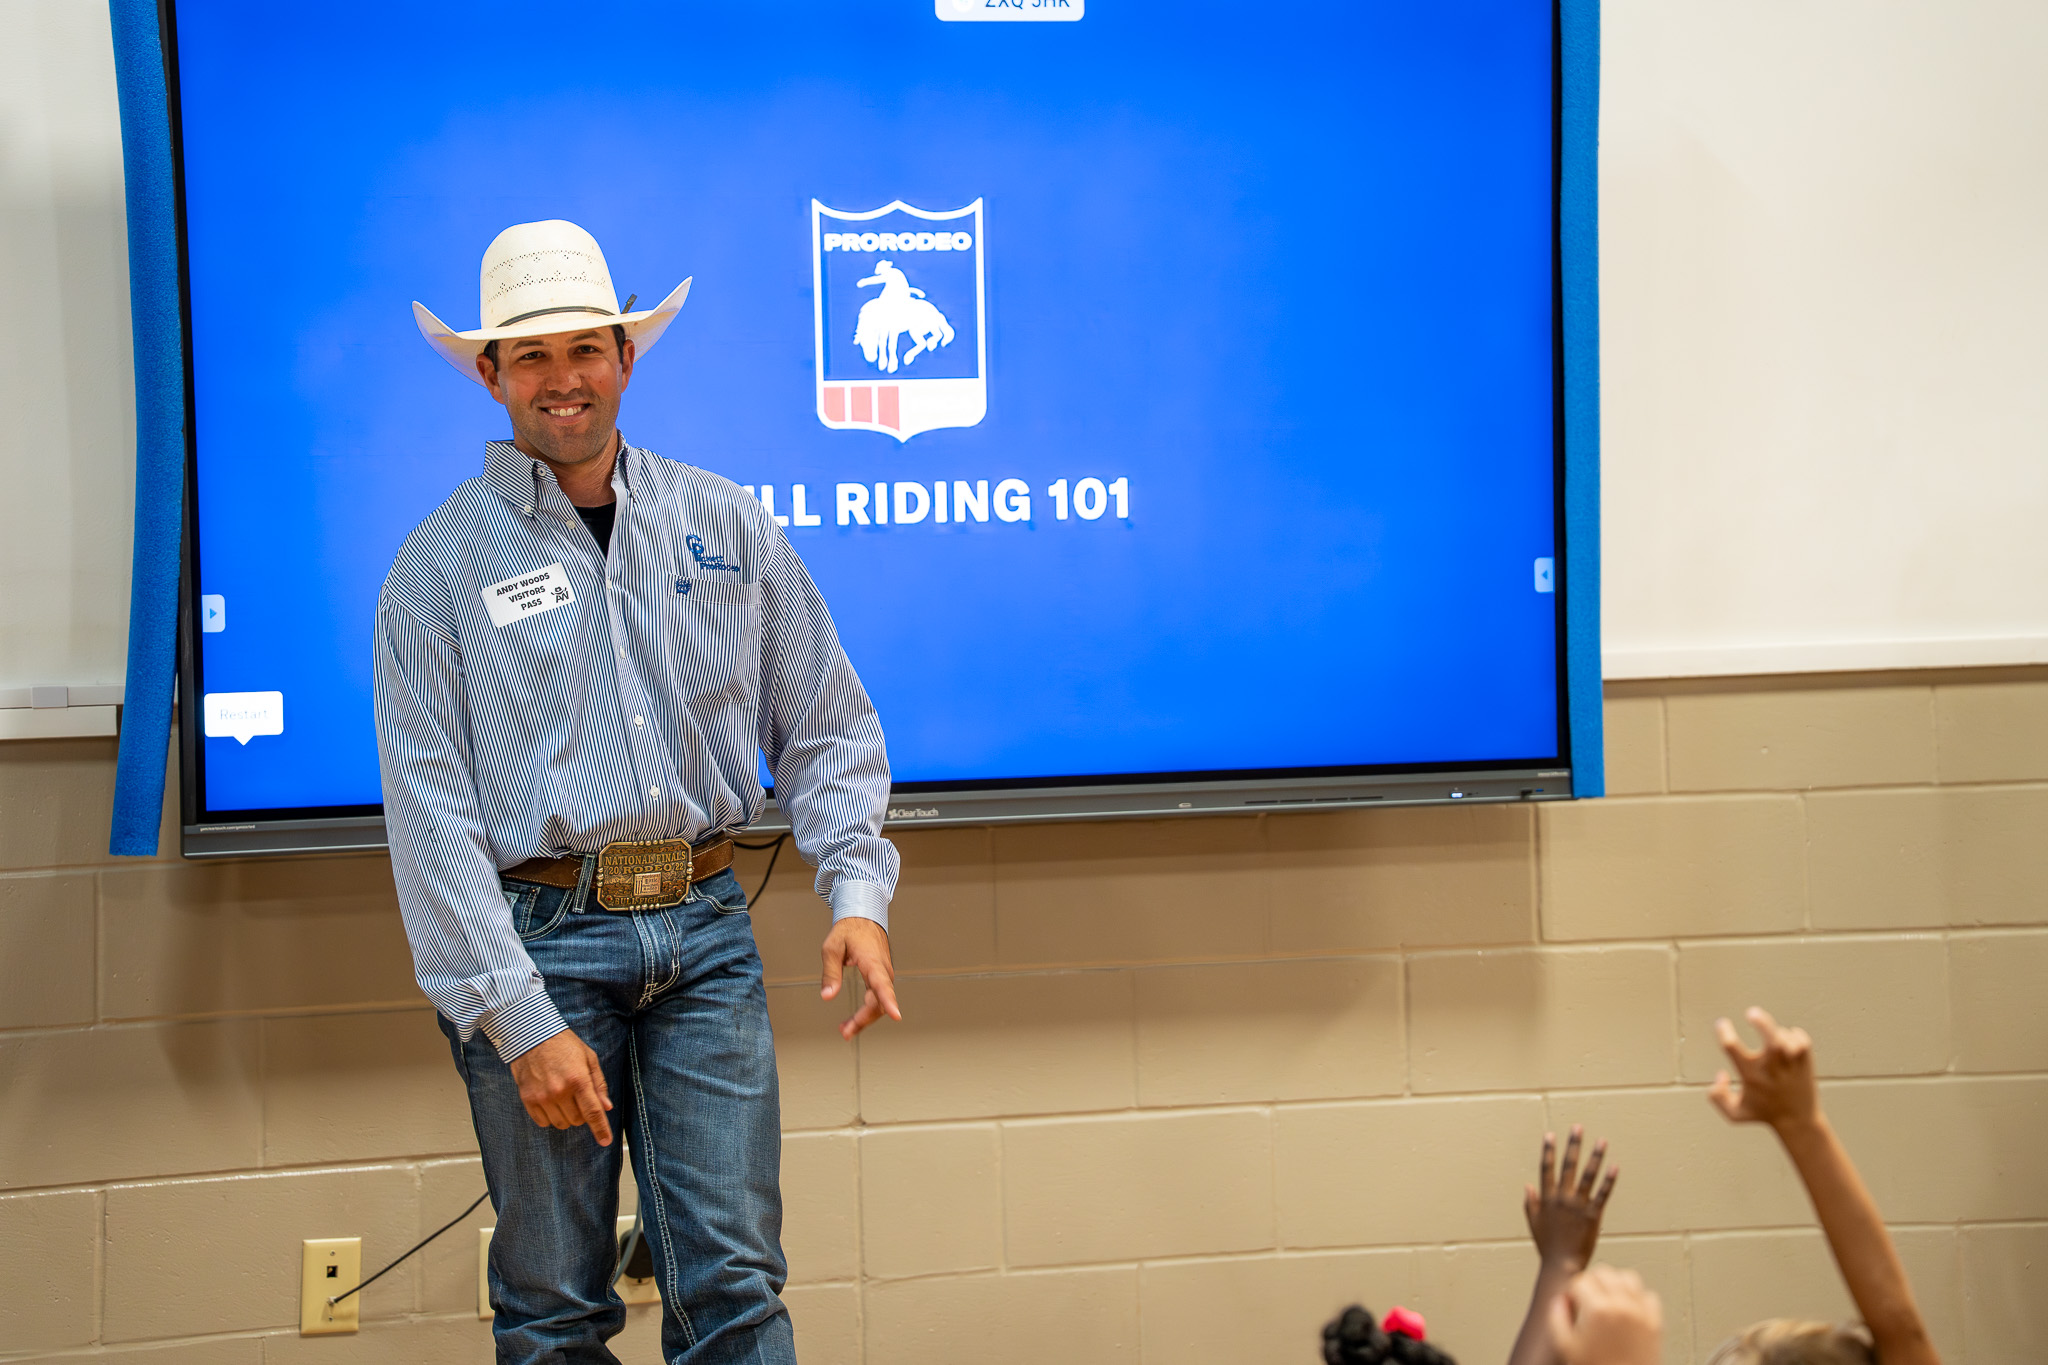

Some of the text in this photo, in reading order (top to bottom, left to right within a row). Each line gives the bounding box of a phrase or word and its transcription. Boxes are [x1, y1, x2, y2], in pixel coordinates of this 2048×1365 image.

[824, 232, 973, 252] PRORODEO
[742, 477, 1129, 527] LL RIDING 101
[496, 572, 550, 596] ANDY WOODS
[508, 585, 546, 603] VISITORS
[520, 598, 543, 611] PASS
[219, 708, 268, 720] Restart
[605, 851, 686, 866] NATIONAL FINALS
[608, 866, 620, 875] 20
[622, 863, 672, 875] RODEO
